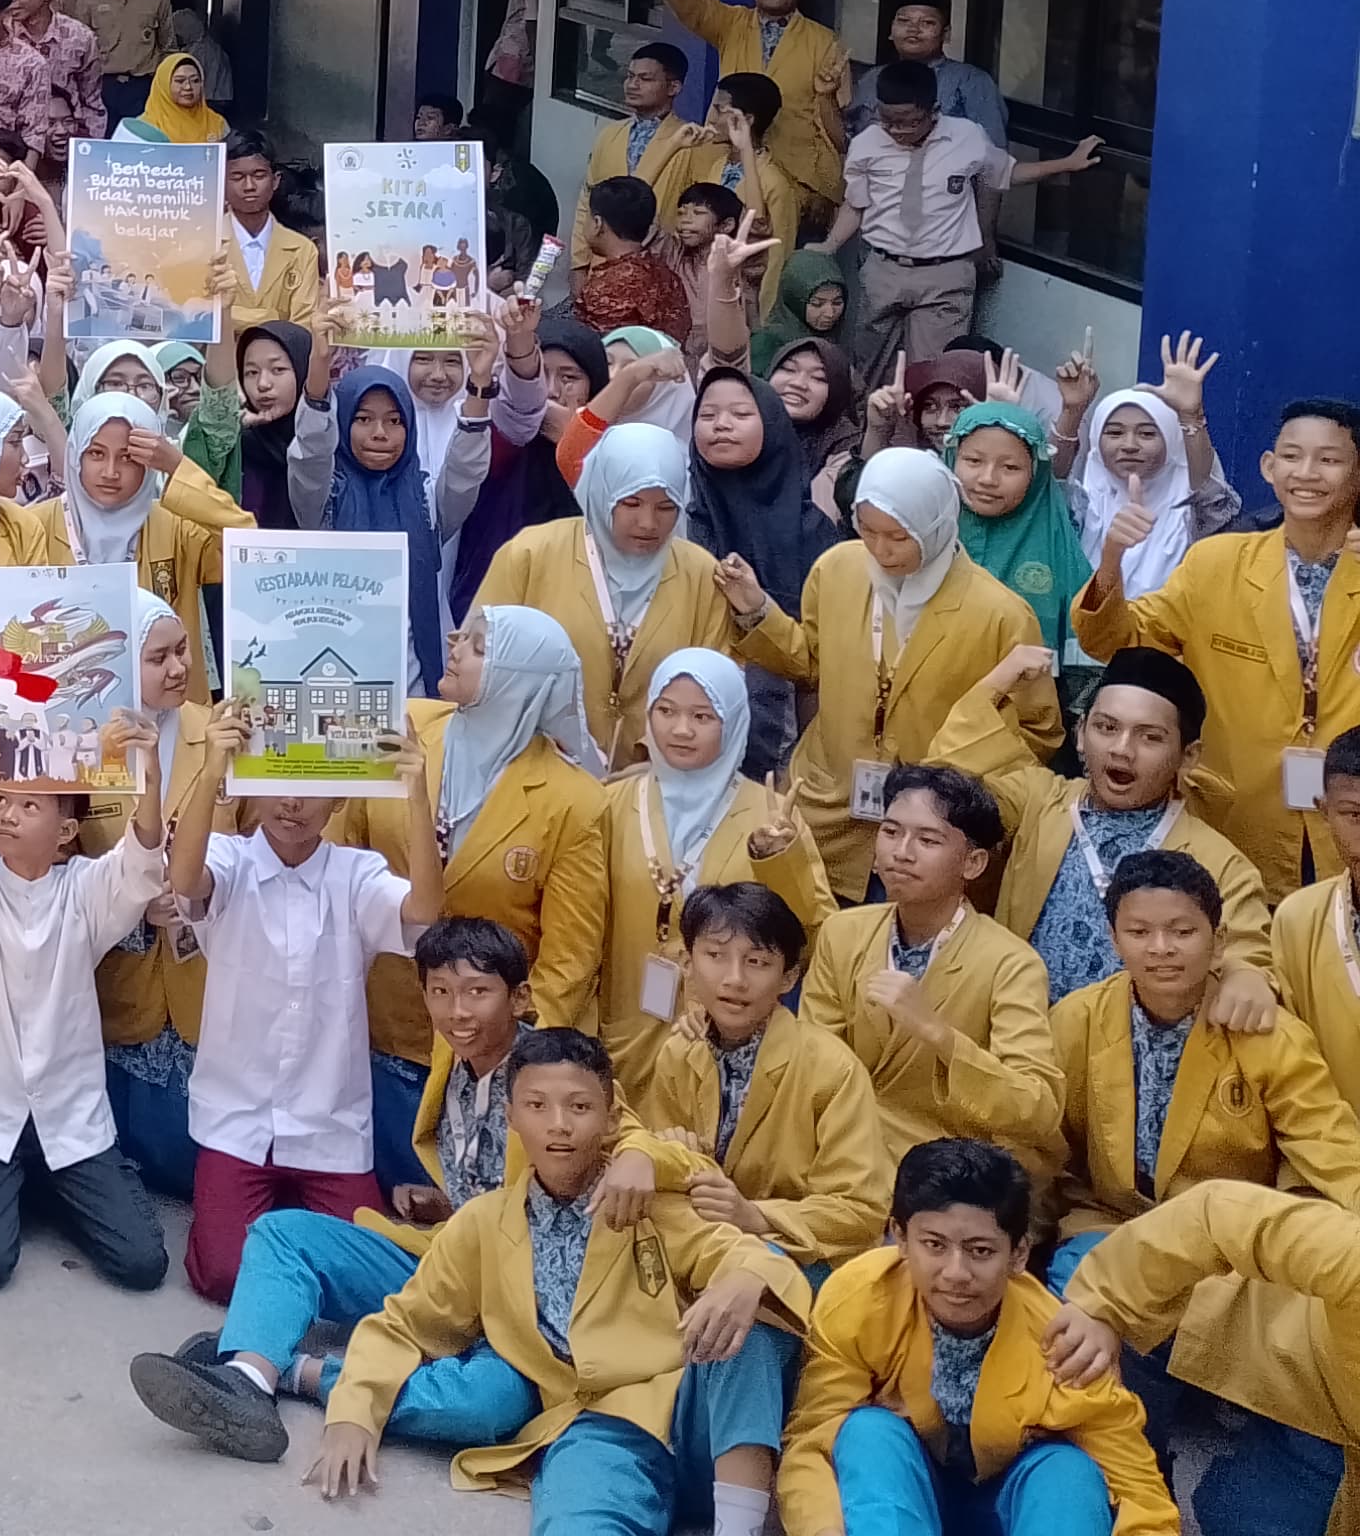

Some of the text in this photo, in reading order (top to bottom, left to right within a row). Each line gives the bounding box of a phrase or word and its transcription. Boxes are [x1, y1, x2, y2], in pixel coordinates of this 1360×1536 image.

[111, 161, 185, 176] Berbeda
[90, 174, 204, 190] Bukan berarti
[382, 178, 427, 197] KITA
[86, 187, 204, 205] Tidak memiliki
[143, 206, 191, 220] untuk
[365, 200, 444, 219] SETARA
[115, 223, 179, 241] belajar
[255, 571, 384, 595] KESETARAAN PELAJAR
